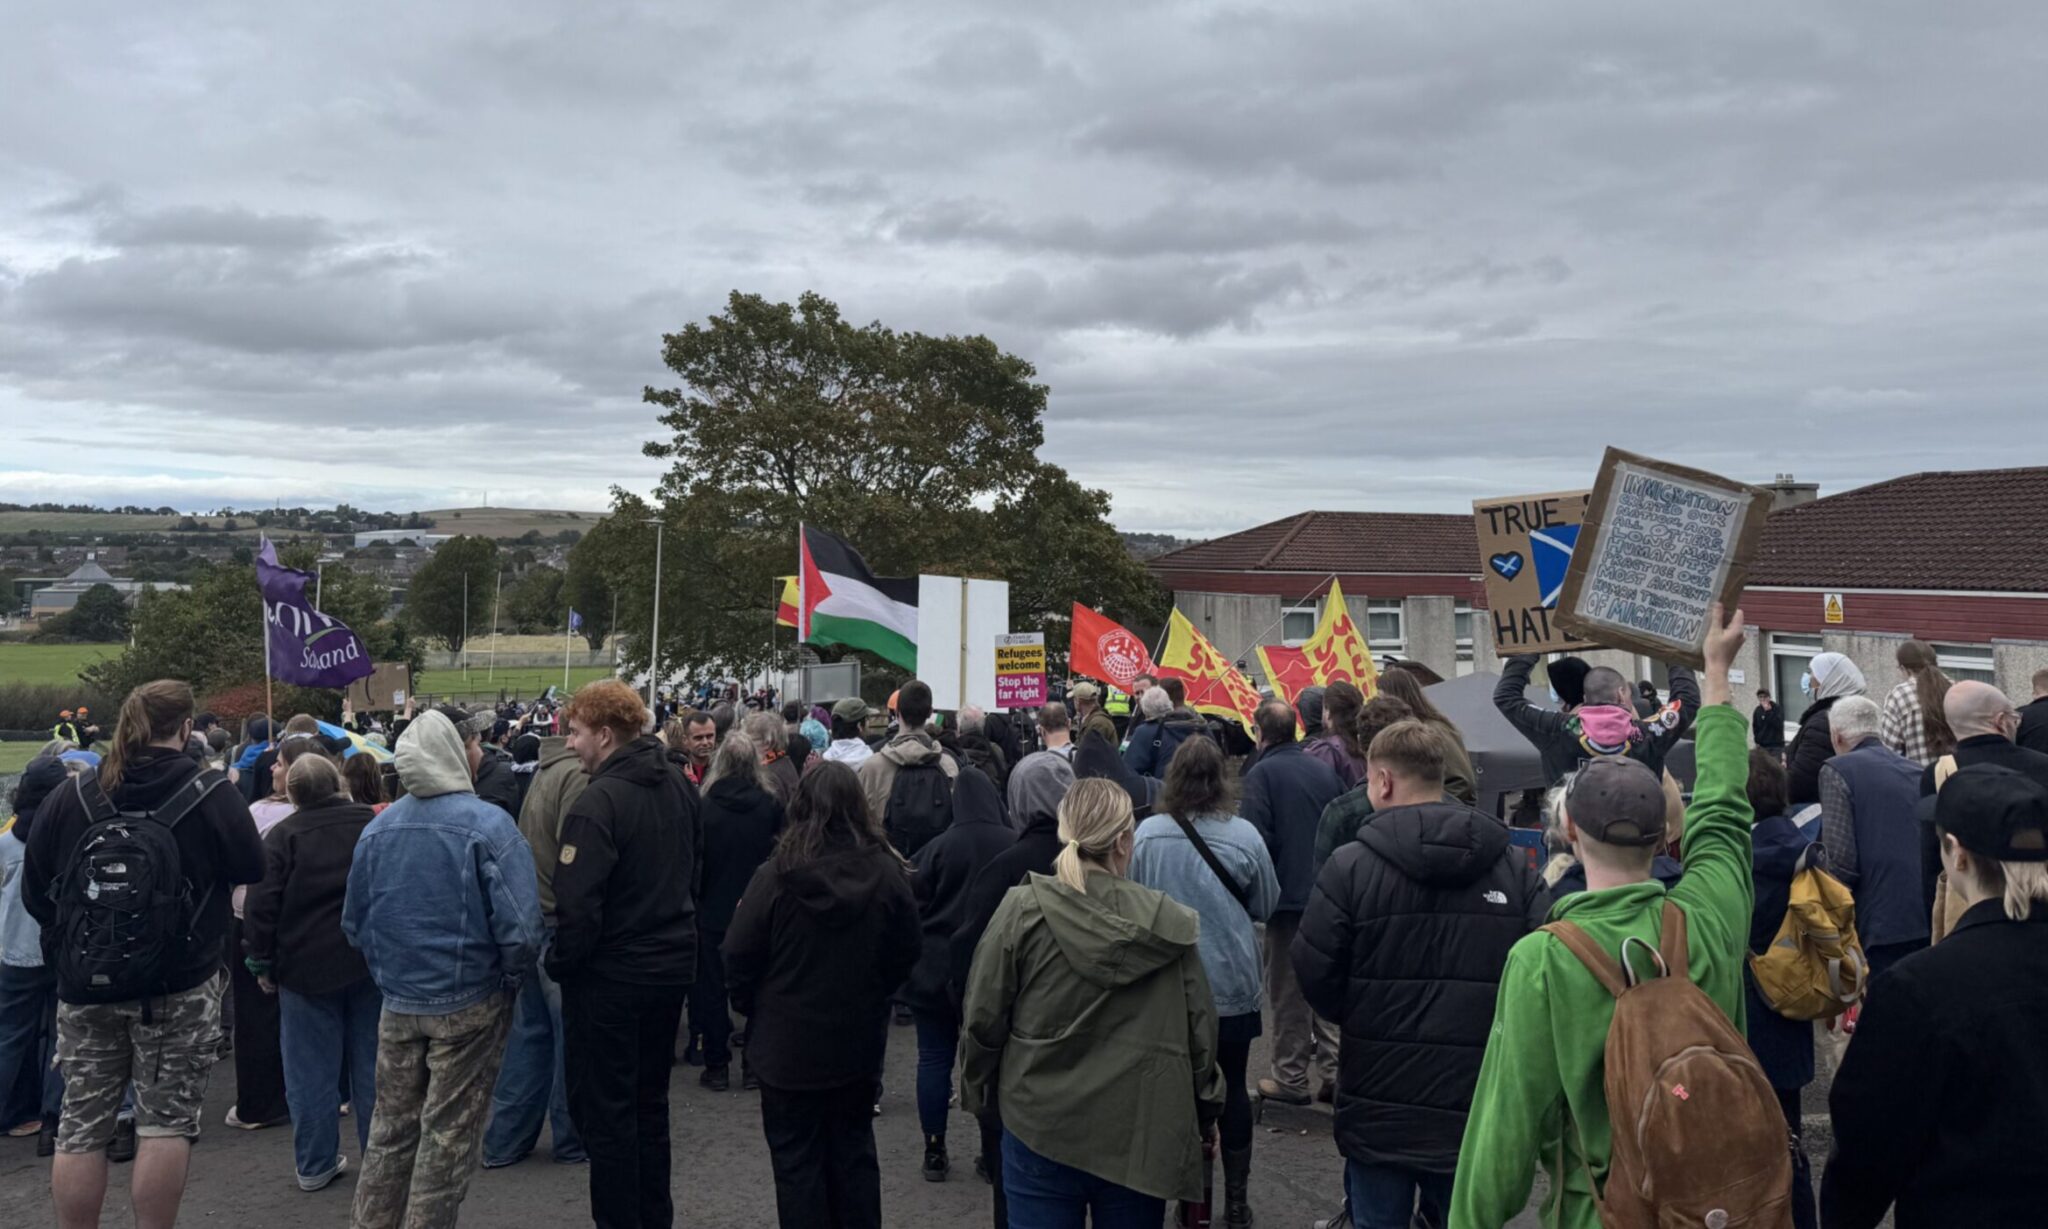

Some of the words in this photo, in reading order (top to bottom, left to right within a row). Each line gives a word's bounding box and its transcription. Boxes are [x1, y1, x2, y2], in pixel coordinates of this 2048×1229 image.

[1481, 498, 1567, 535] TRUE
[1612, 516, 1643, 531] ALL
[1620, 493, 1682, 515] CREATED
[1687, 509, 1727, 528] OUR
[1612, 527, 1676, 551] LONG
[1680, 545, 1722, 566] MAY
[1684, 521, 1722, 538] AND
[1606, 537, 1716, 576] HUMANITY
[1592, 577, 1638, 601] HUMAN
[1640, 589, 1706, 617] TRADITION
[1597, 564, 1646, 586] MOST
[1647, 575, 1712, 602] ANCIENT
[1677, 570, 1712, 589] OUR
[1494, 606, 1584, 645] HAT
[1586, 592, 1610, 617] OF
[1606, 598, 1702, 642] MIGRATION
[997, 648, 1043, 661] Refugees
[997, 660, 1041, 671] welcome
[997, 676, 1021, 688] Stop
[1022, 675, 1040, 686] the
[998, 688, 1013, 699] far
[1015, 687, 1040, 700] right
